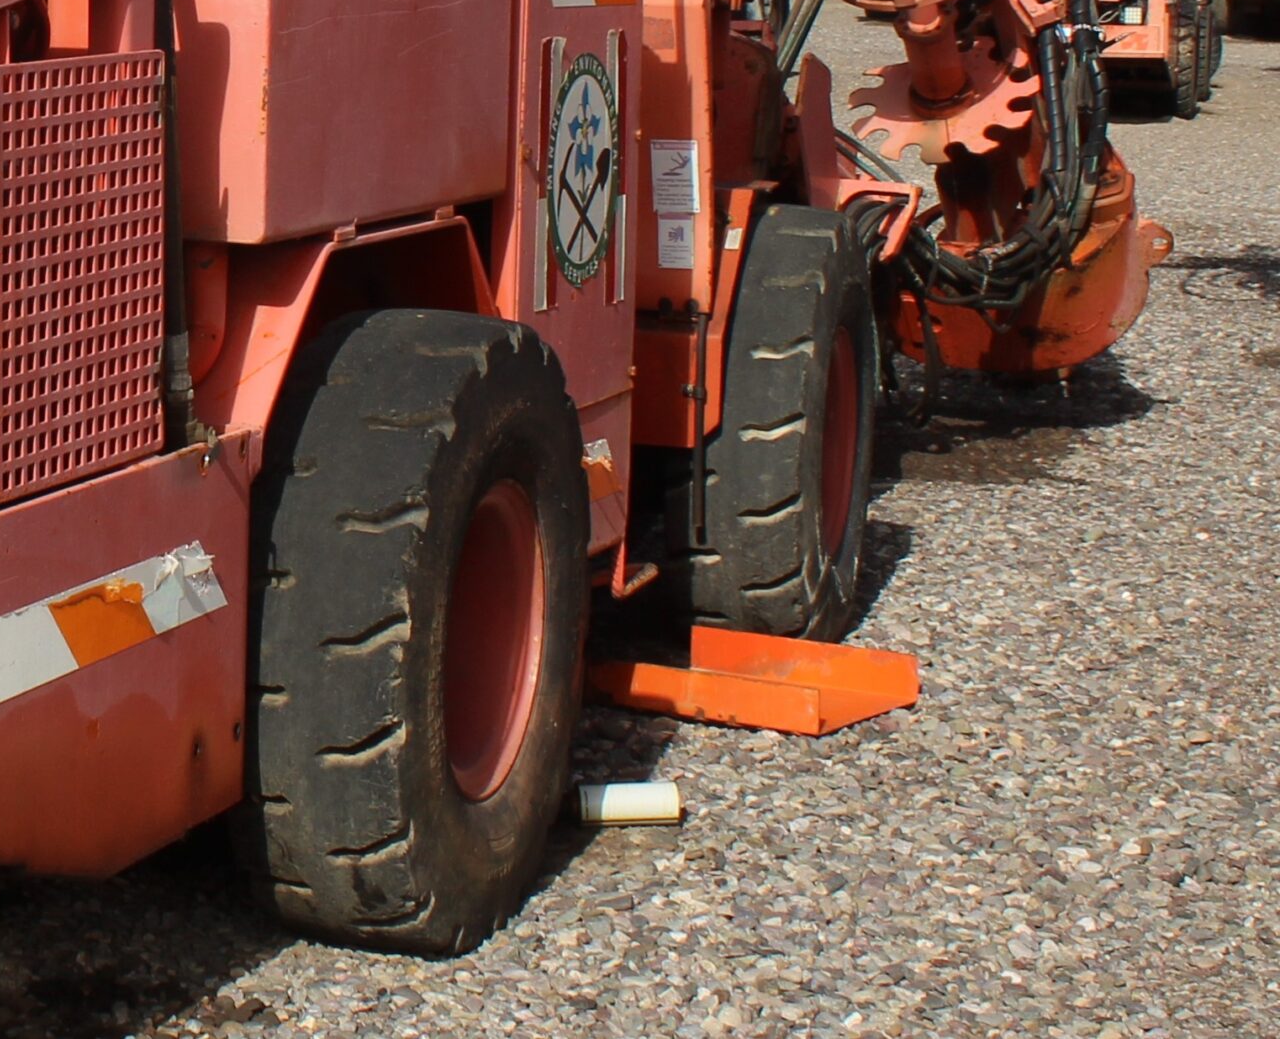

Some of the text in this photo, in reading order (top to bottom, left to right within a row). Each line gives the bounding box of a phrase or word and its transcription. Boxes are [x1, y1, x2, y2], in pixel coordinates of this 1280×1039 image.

[547, 103, 562, 190] MINING
[574, 54, 619, 171] ENVIRONMENTAL
[564, 259, 599, 286] SERVICES
